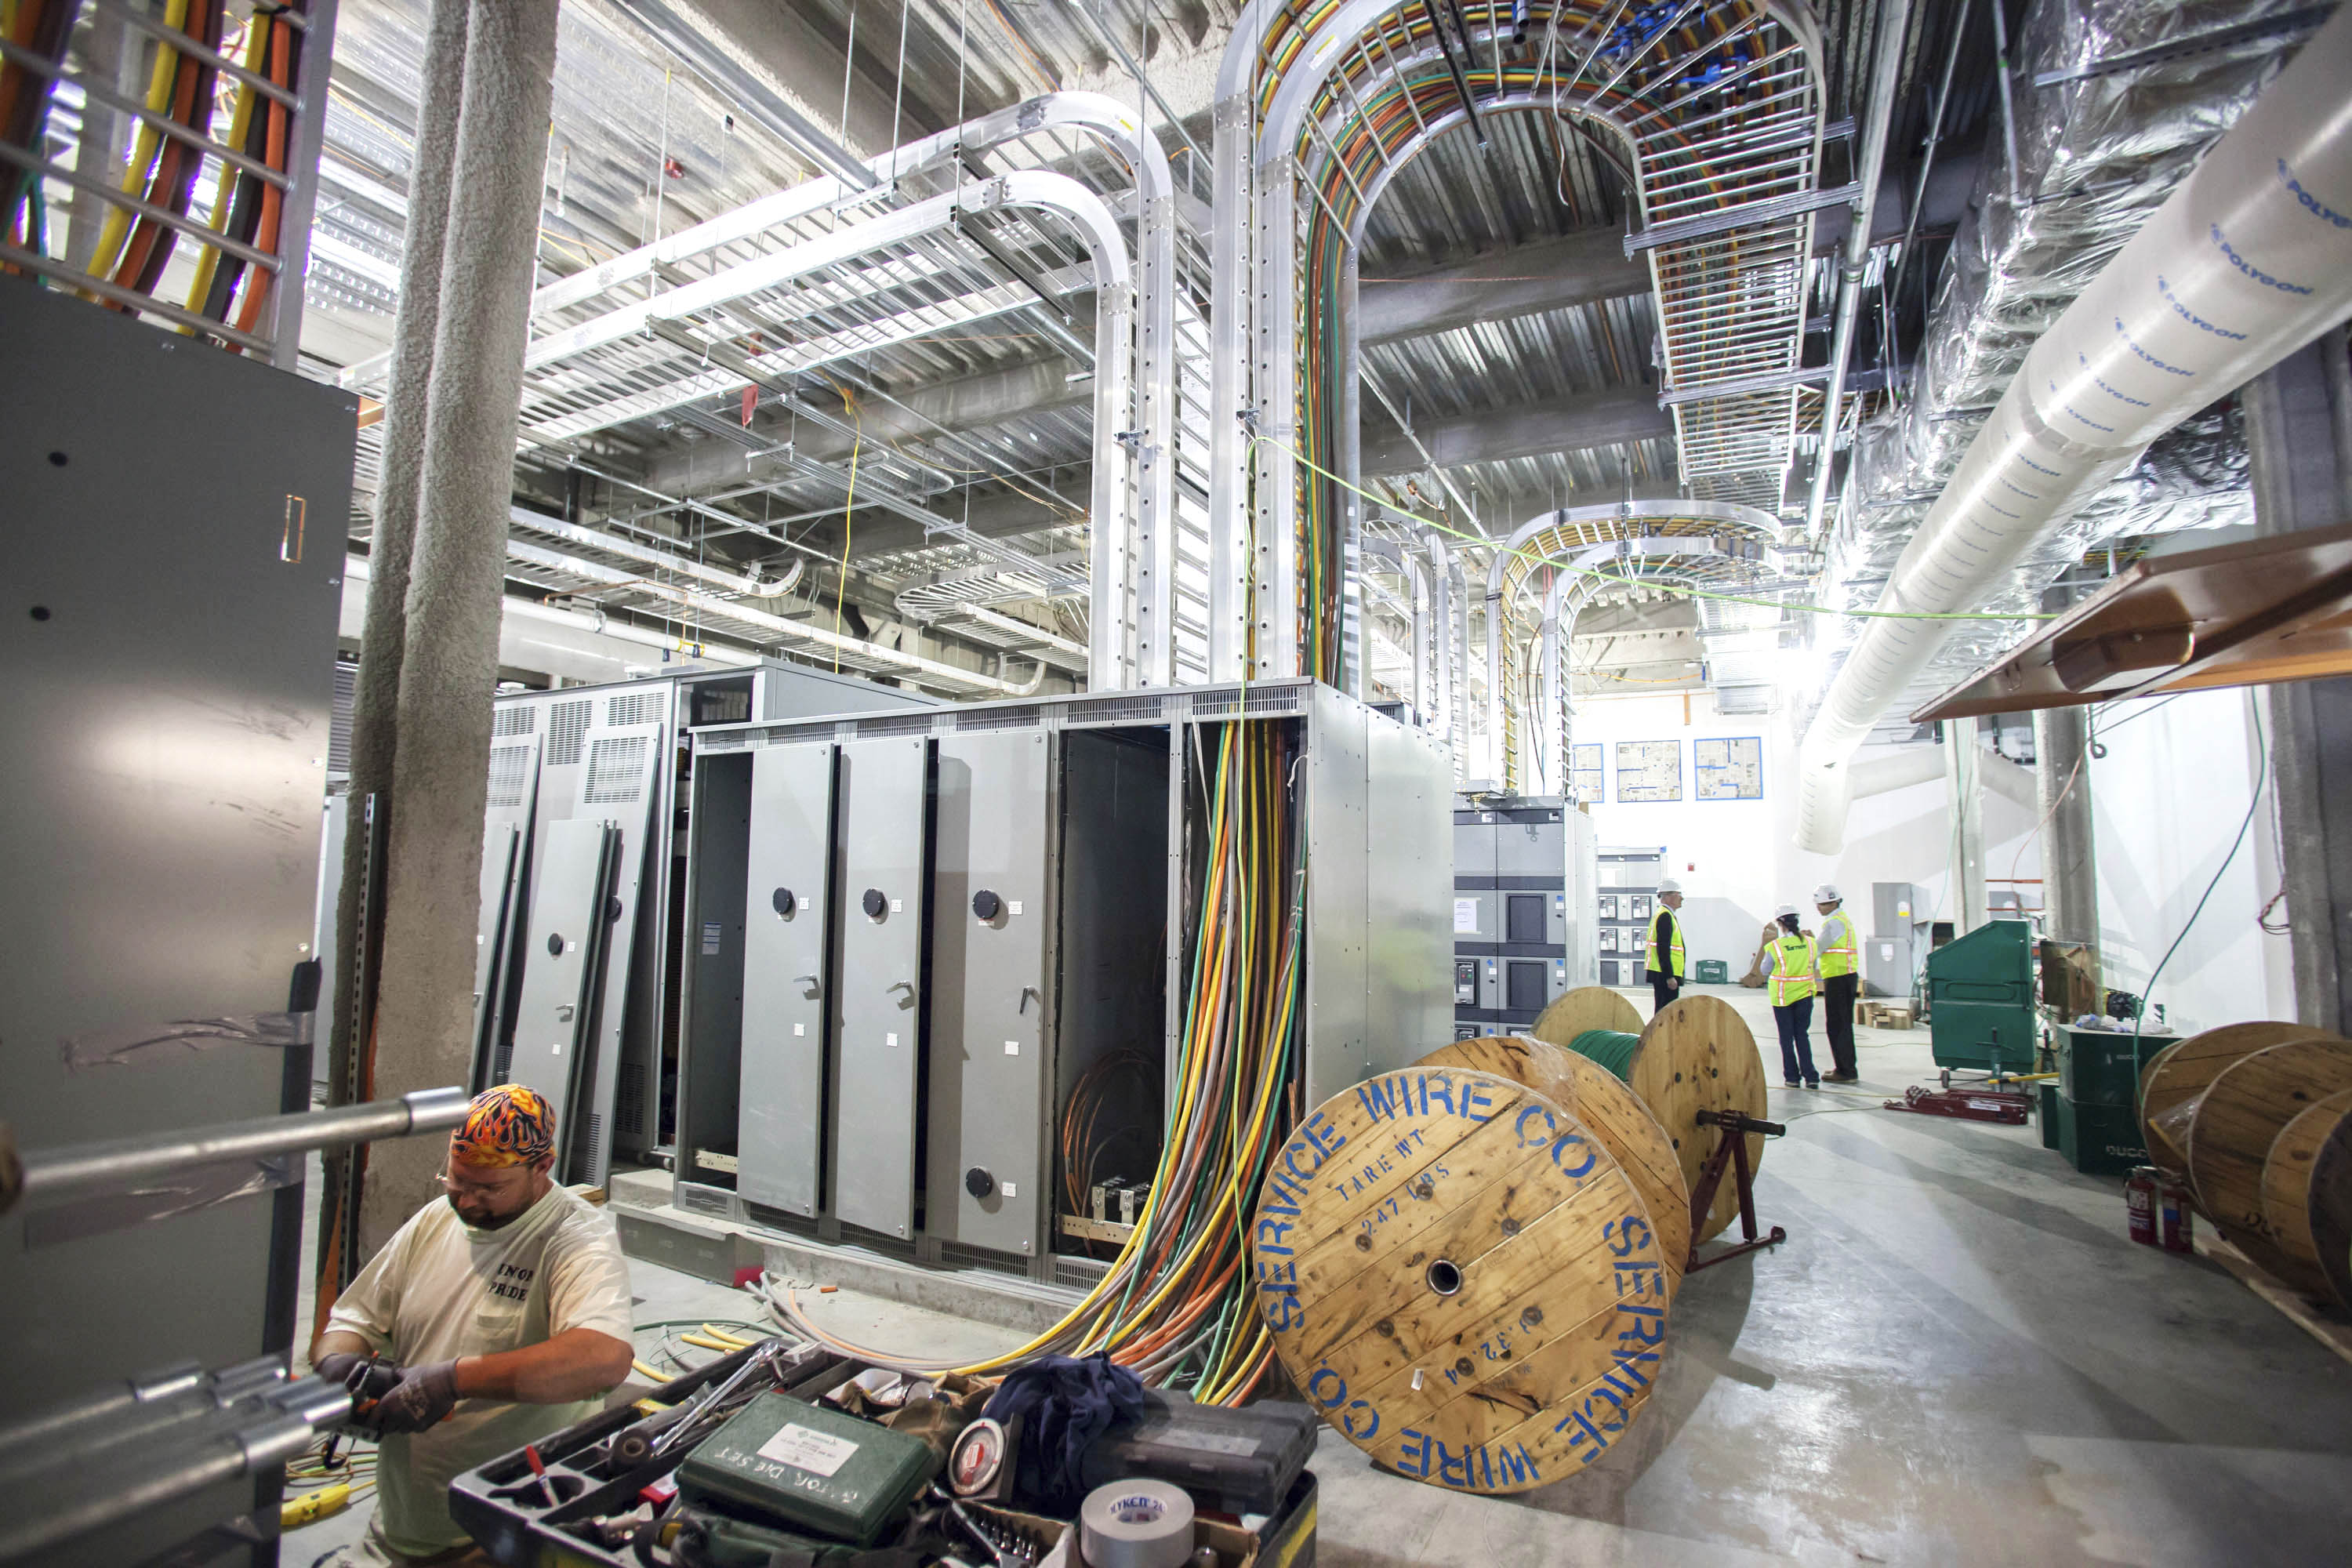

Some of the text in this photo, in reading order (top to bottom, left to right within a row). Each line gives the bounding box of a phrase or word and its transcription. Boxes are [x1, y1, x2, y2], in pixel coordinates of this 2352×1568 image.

[2220, 242, 2314, 295] POLYGON
[1335, 1128, 1425, 1202] TARE WT
[1361, 1162, 1450, 1236] 247 LBS
[1258, 1112, 1347, 1333] SERVICE
[1356, 1074, 1494, 1123] WIRE
[488, 1280, 528, 1301] PRIDE
[1555, 1215, 1664, 1464] SERVICE
[1397, 1427, 1541, 1489] WIRE
